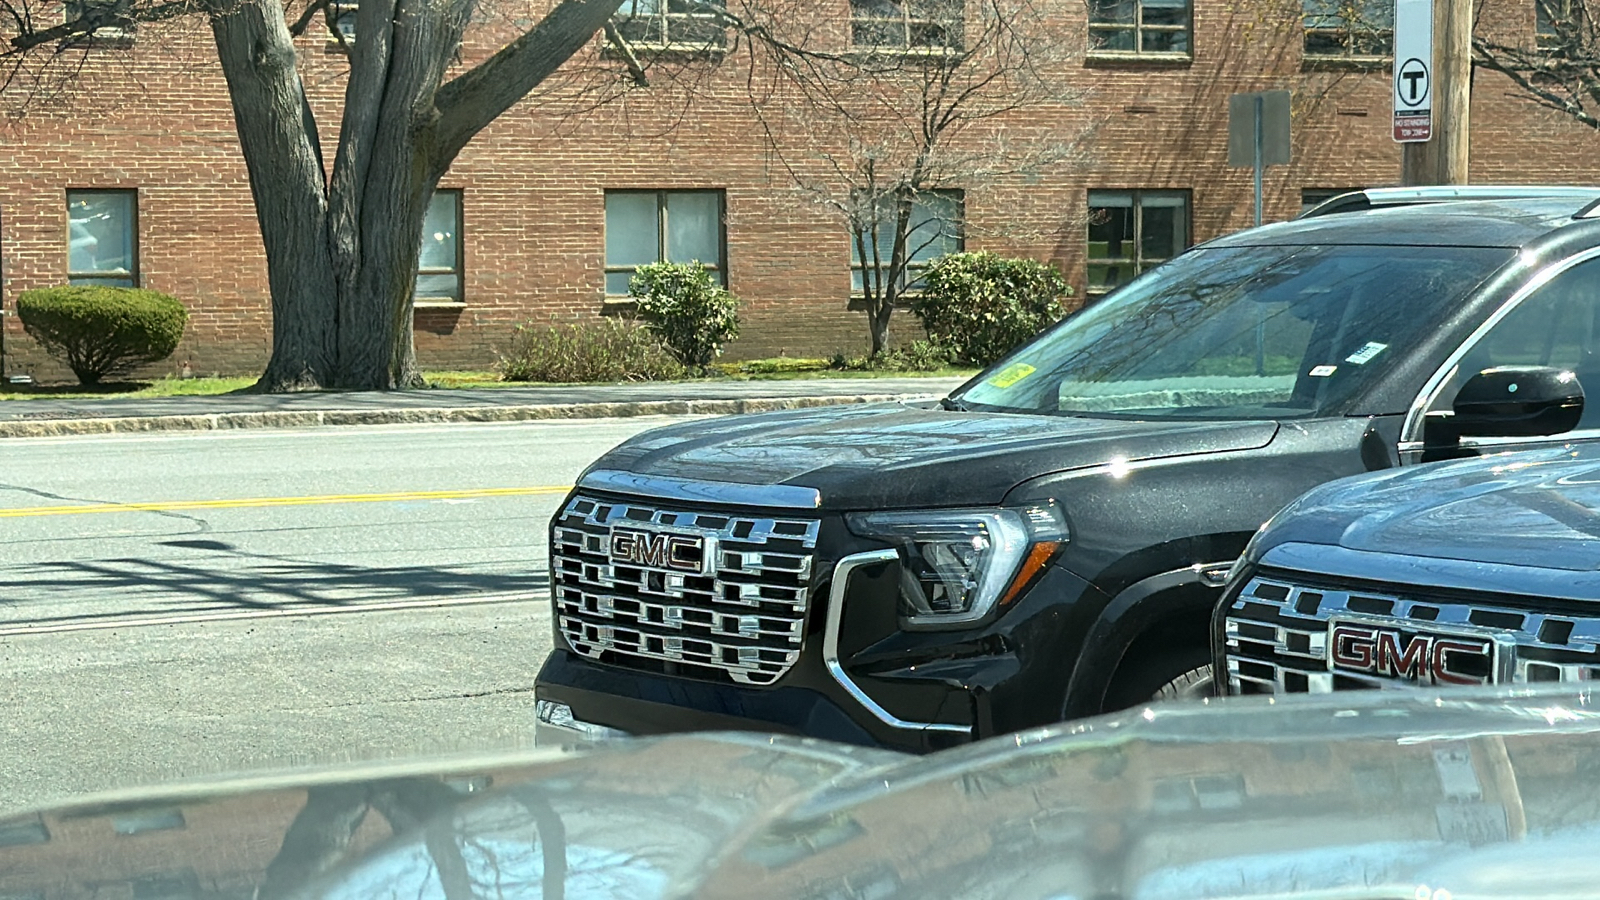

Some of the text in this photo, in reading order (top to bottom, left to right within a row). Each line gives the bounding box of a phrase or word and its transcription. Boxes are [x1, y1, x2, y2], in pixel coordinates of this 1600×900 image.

[1403, 71, 1424, 99] T
[610, 531, 702, 572] GMC
[1332, 626, 1490, 686] GMC
